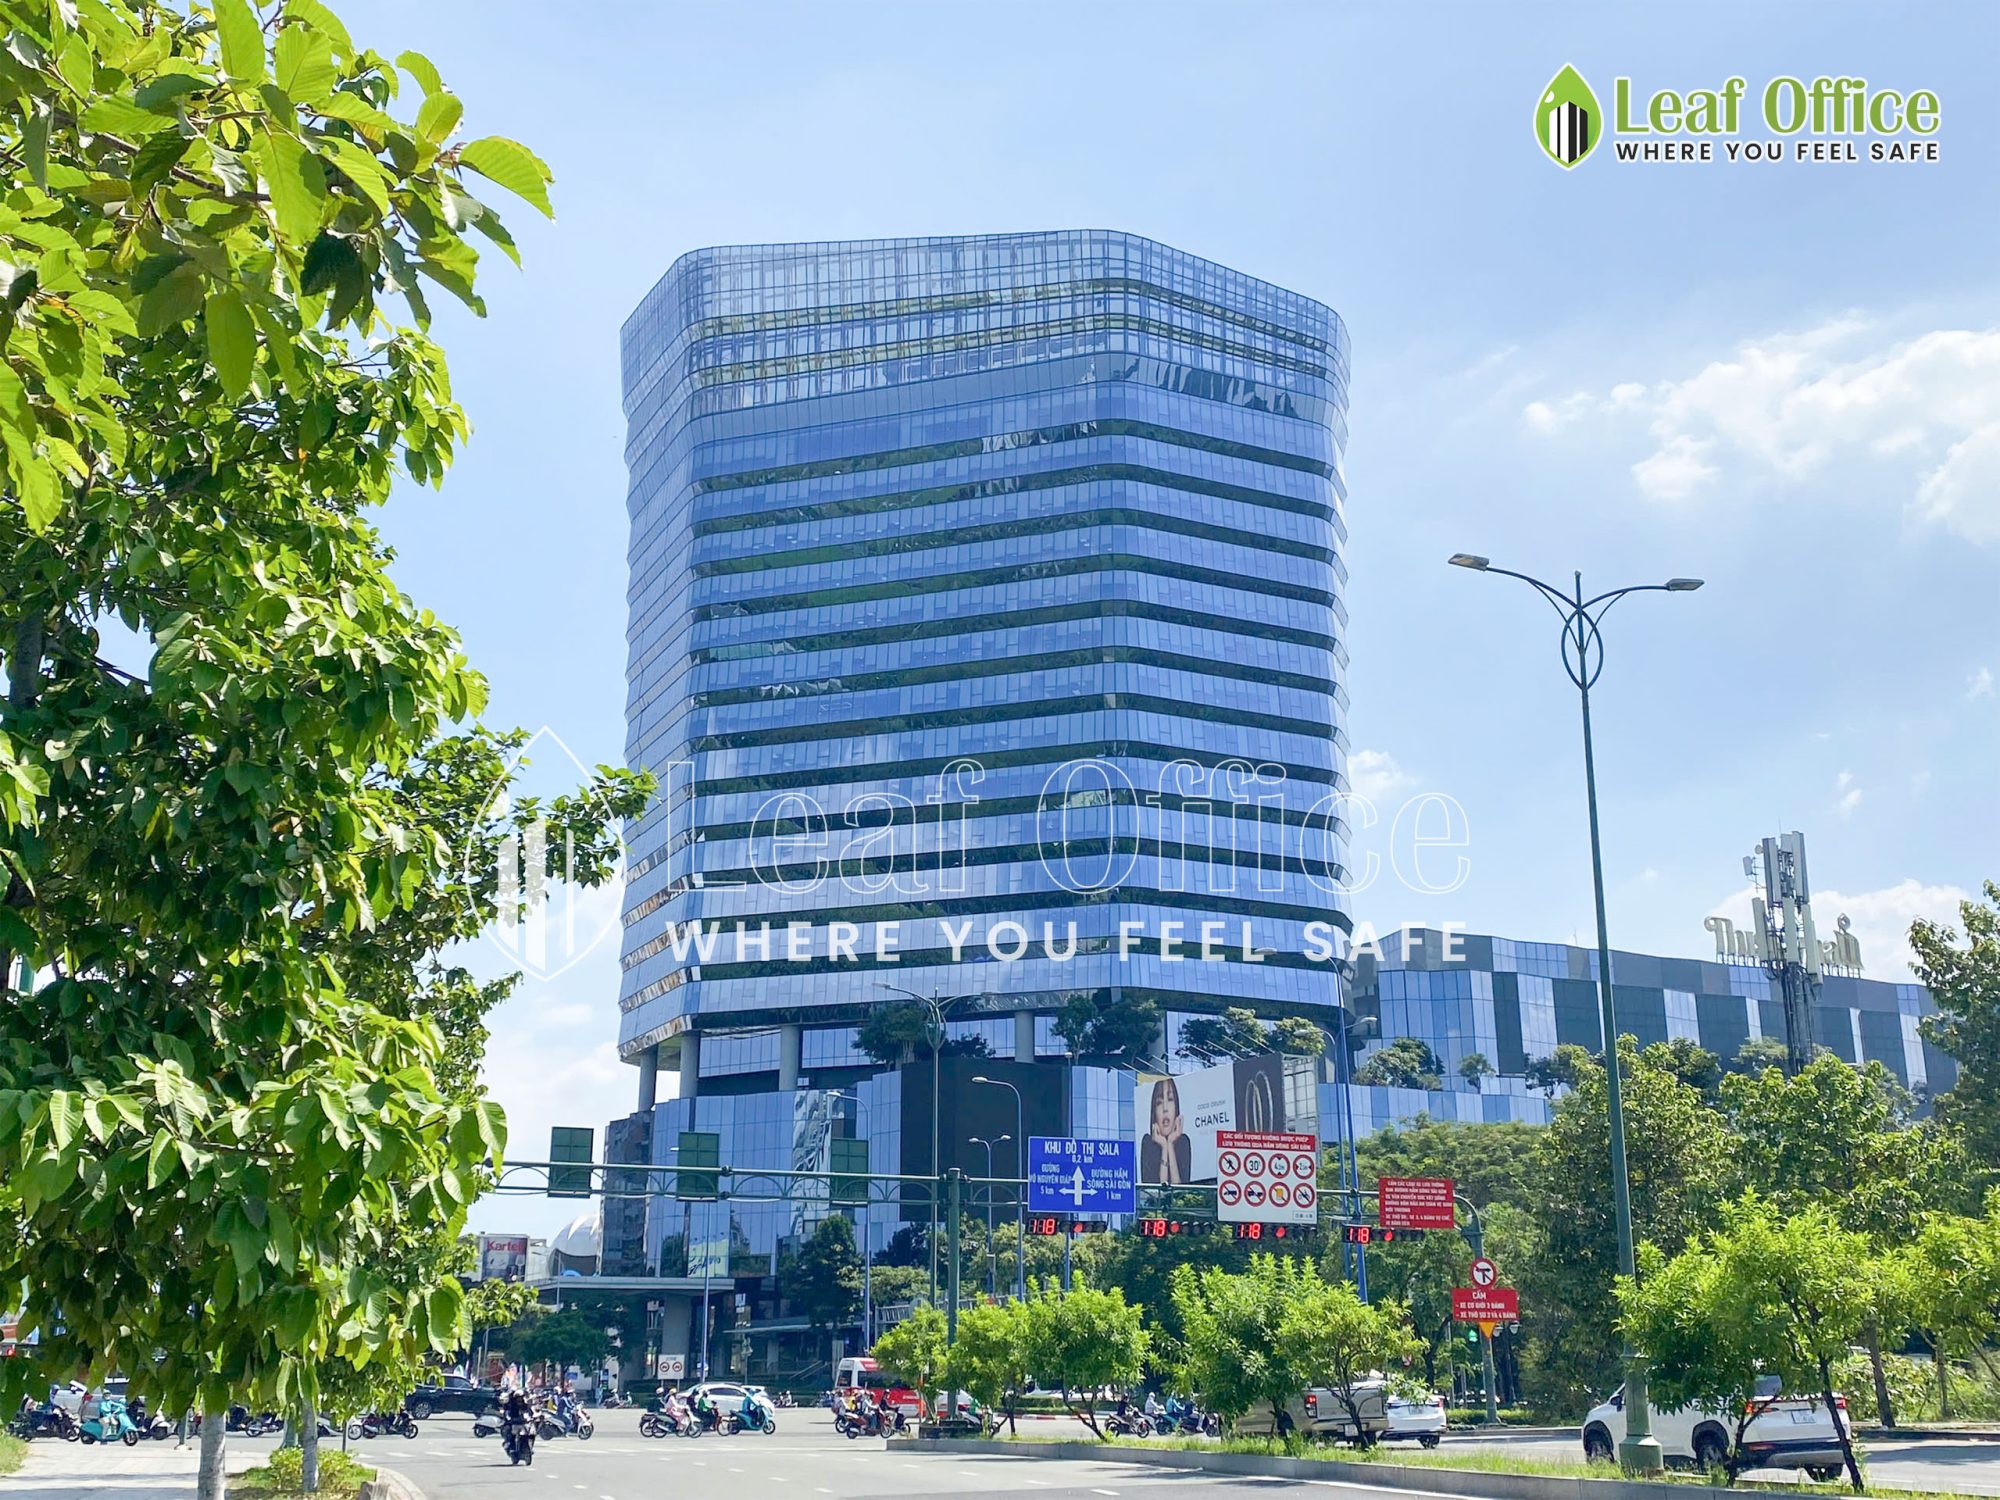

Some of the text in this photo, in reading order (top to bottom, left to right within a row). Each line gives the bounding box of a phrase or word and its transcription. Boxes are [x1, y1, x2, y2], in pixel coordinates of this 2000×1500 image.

[1195, 1112, 1229, 1127] CHANEL
[1045, 1141, 1061, 1153] KHU
[1082, 1142, 1094, 1155] THỊ
[1099, 1143, 1119, 1155] SALA
[1084, 1155, 1093, 1163] km
[1041, 1186, 1054, 1195] 5 km
[1087, 1179, 1131, 1190] SÔNG SÀI GÒN
[1106, 1191, 1121, 1200] 1 km
[1033, 1218, 1055, 1235] 118
[1145, 1220, 1166, 1237] 118
[1240, 1223, 1261, 1239] 118
[1350, 1227, 1369, 1244] 118
